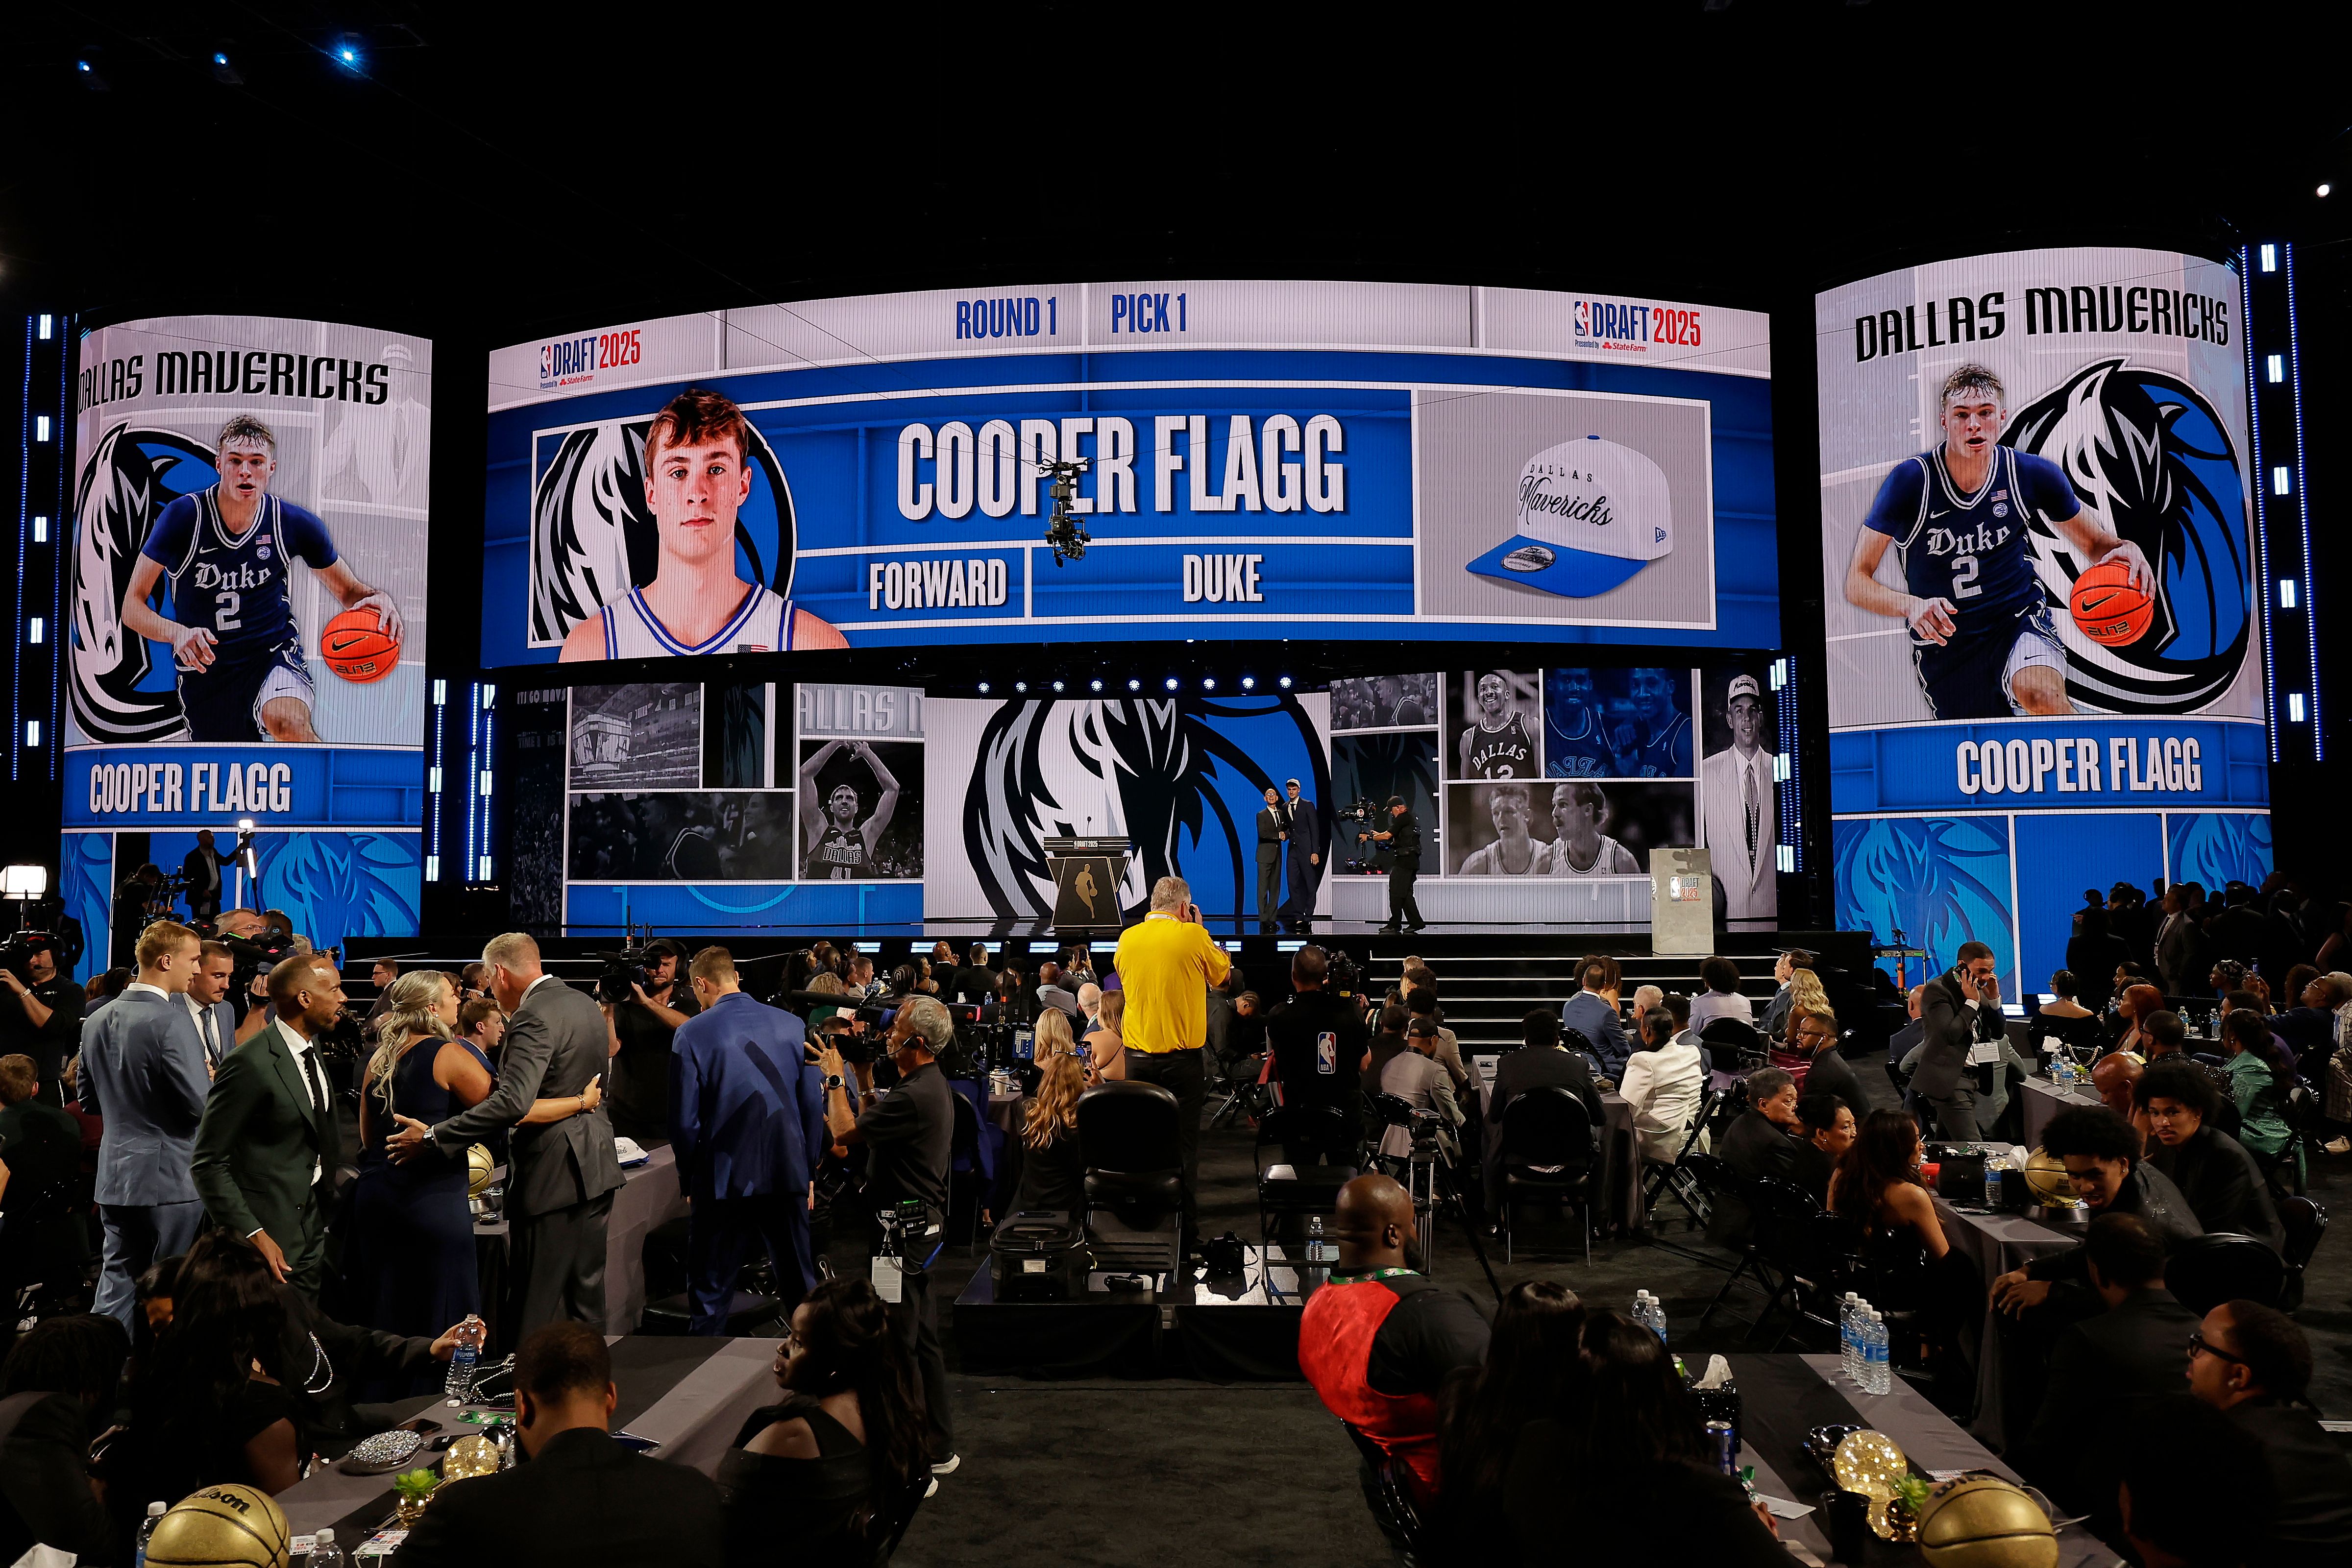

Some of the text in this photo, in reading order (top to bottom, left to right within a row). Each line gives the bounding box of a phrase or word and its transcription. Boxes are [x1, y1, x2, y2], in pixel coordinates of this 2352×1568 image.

[956, 297, 1056, 339] ROUND 1
[1112, 292, 1186, 333] PICK 1
[1592, 302, 1701, 346] DRAFT 2025
[1856, 286, 2229, 363] DALLAS MAVERICKS
[553, 329, 640, 377] DRAFT 2025
[1575, 339, 1594, 348] Presented
[78, 351, 389, 415] DALLAS MAVERICKS
[540, 381, 554, 389] Presented
[897, 414, 1344, 521] COOPER FLAGG
[1530, 464, 1592, 482] DALLAS
[1519, 476, 1613, 526] Mavericks
[1927, 522, 2010, 556] Duke
[195, 562, 271, 591] Duke
[869, 558, 1007, 610] FORWARD
[1183, 554, 1263, 603] DUKE
[1952, 555, 1982, 599] 2
[216, 591, 241, 631] 2
[2086, 621, 2130, 636] ELITE
[335, 662, 376, 674] ELITE
[1472, 741, 1527, 771] DALLAS
[1957, 736, 2202, 795] COOPER FLAGG
[90, 762, 291, 813] COOPER FLAGG
[823, 846, 861, 864] DALLAS
[1681, 877, 1699, 887] DRAFT
[1681, 887, 1698, 897] 2025
